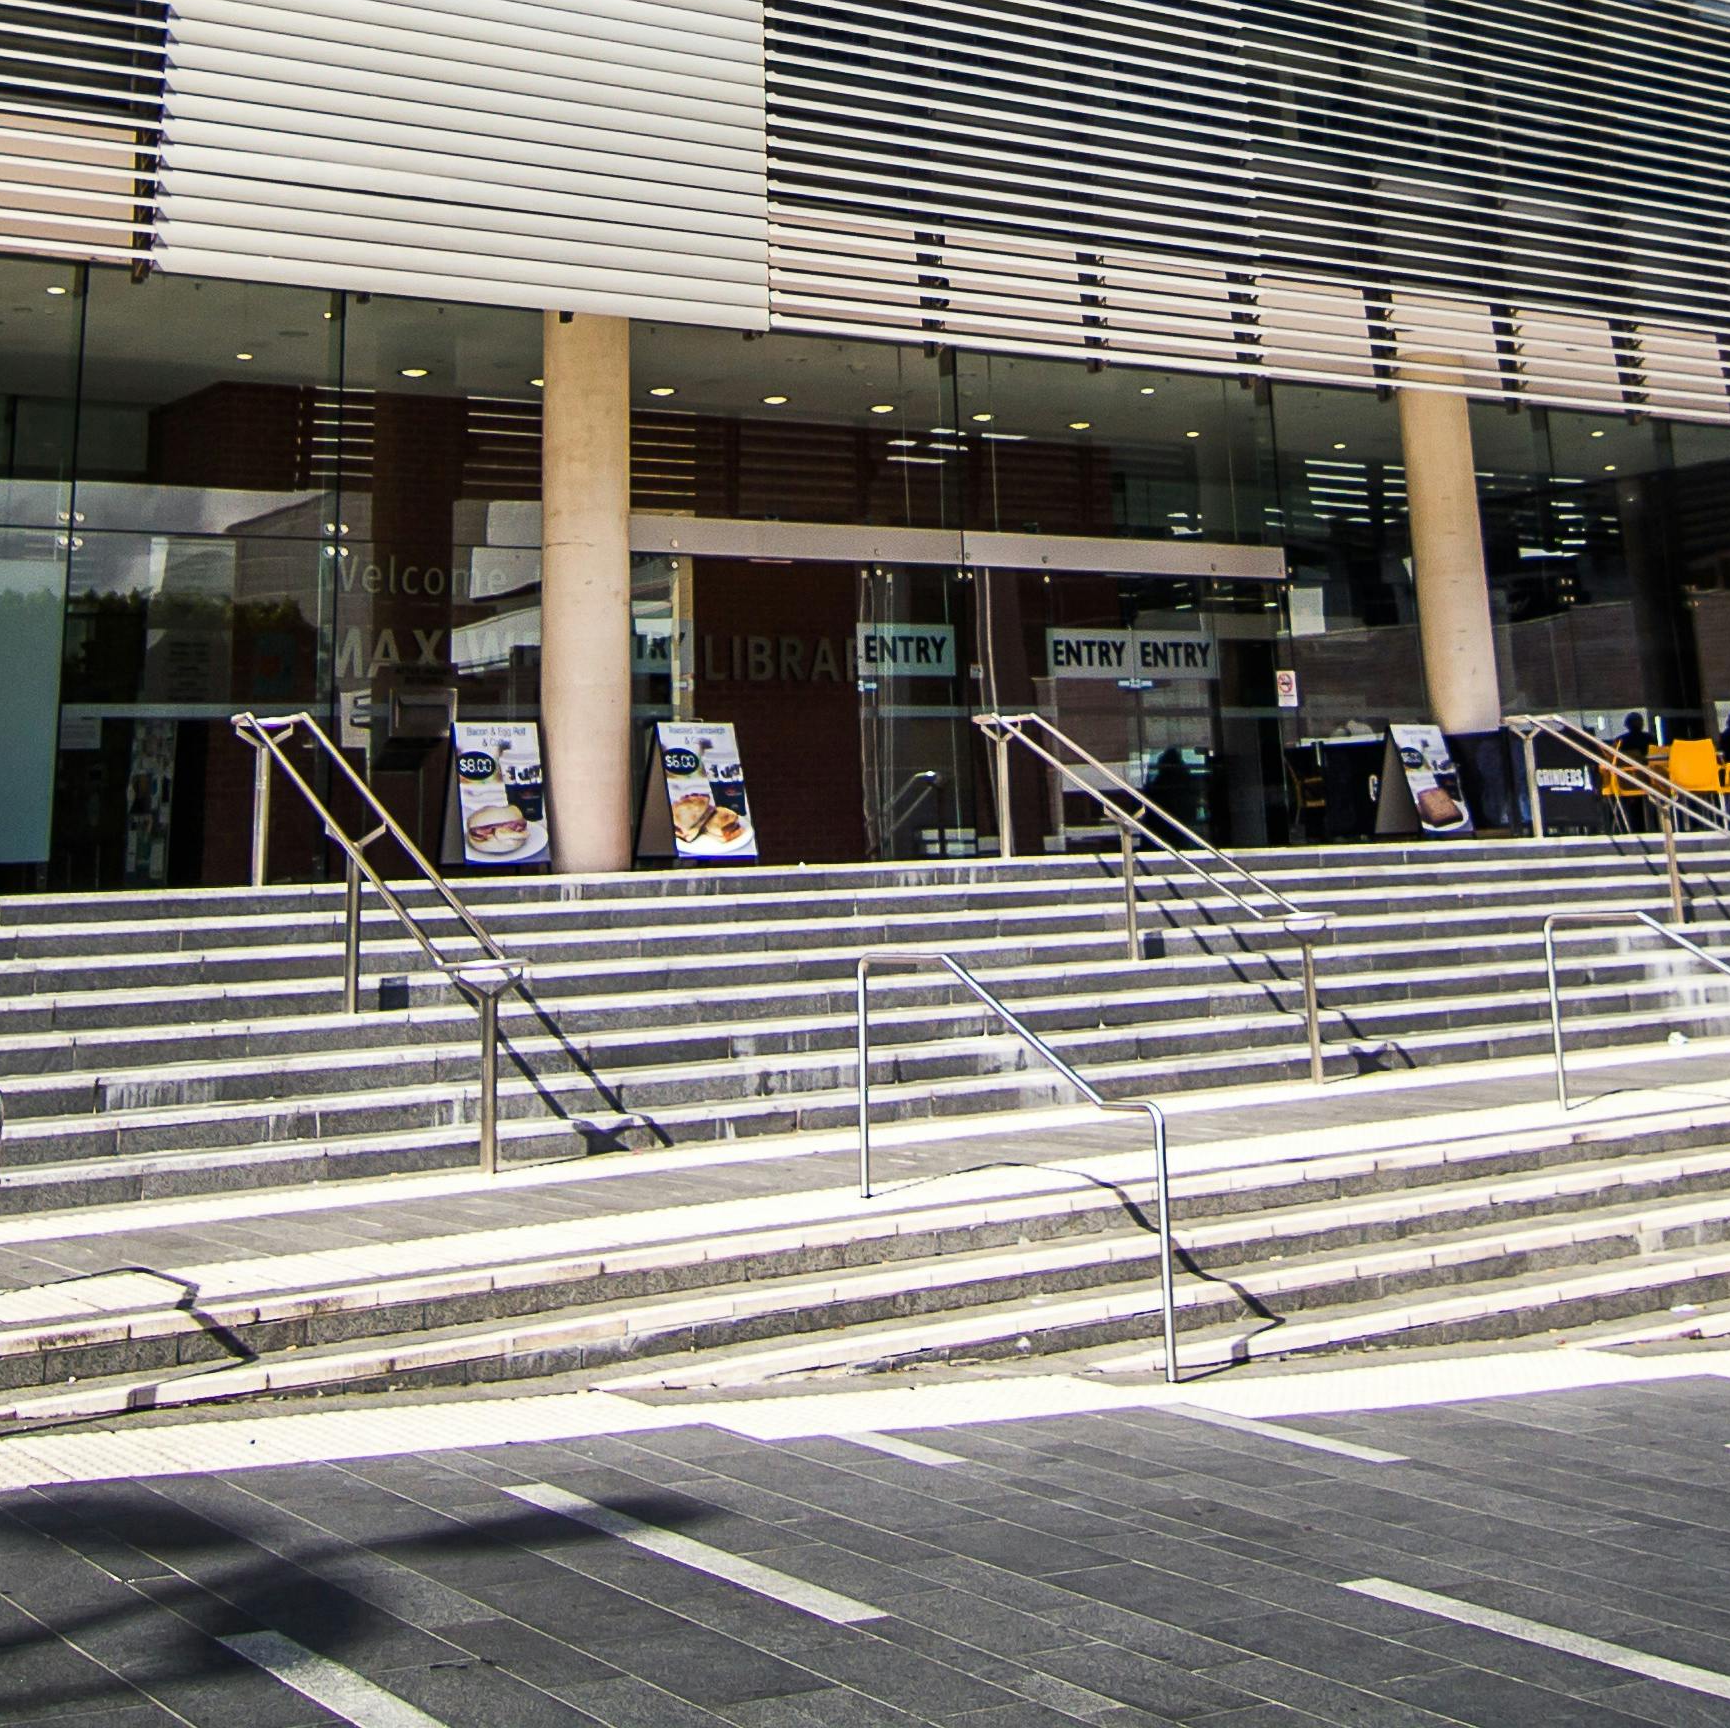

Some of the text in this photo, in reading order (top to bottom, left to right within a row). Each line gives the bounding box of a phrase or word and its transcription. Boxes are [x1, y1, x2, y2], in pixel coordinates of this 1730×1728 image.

[704, 633, 858, 682] LIBRA
[864, 634, 947, 664] ENTRY
[1052, 639, 1126, 667] ENTRY
[1140, 640, 1211, 669] ENTRY
[459, 758, 492, 773] $8.00
